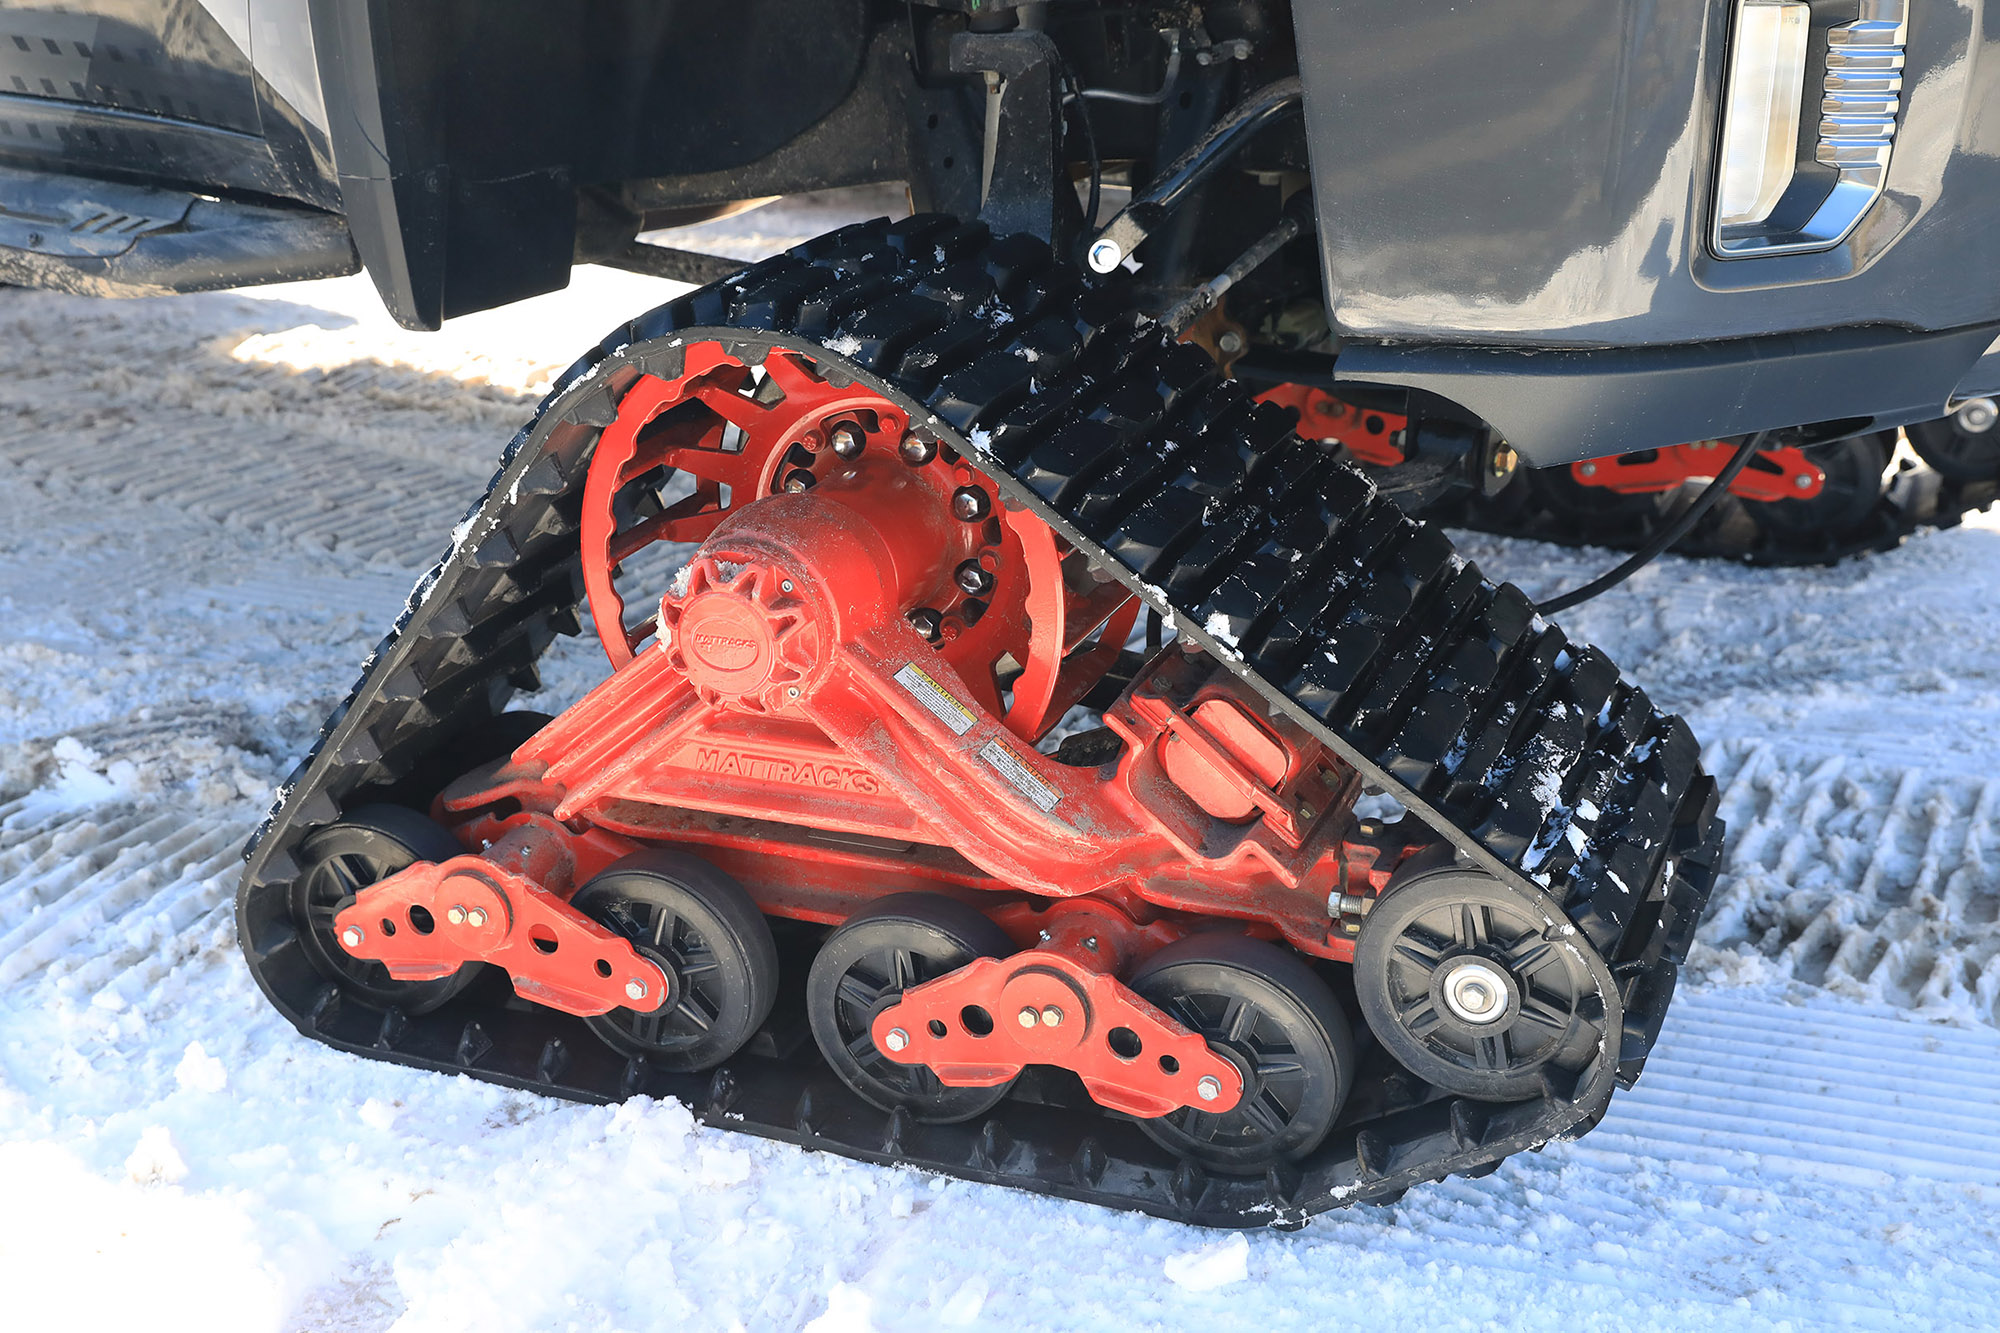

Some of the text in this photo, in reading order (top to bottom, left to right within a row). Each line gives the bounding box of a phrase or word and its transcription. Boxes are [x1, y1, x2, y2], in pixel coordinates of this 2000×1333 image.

[695, 633, 757, 650] MATTRACKS
[921, 673, 965, 711] CAUTION!
[696, 748, 880, 795] MATTRACKS
